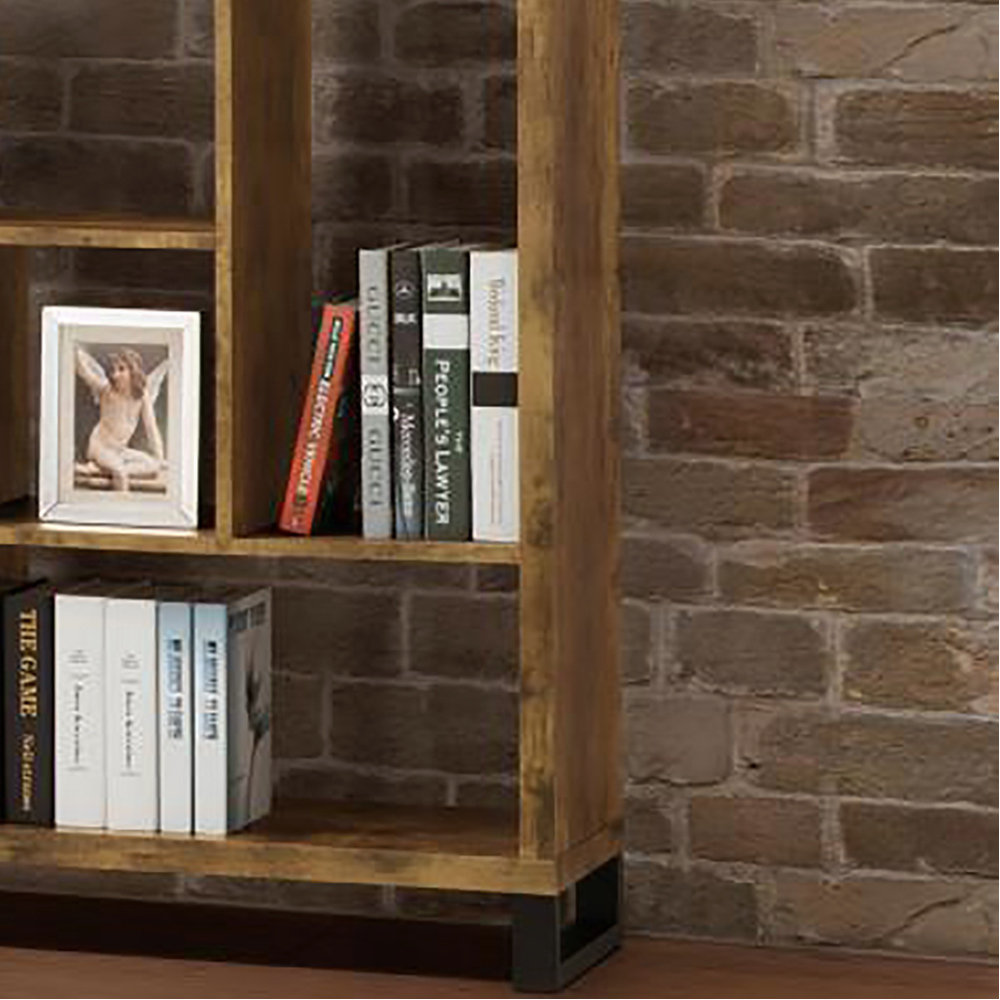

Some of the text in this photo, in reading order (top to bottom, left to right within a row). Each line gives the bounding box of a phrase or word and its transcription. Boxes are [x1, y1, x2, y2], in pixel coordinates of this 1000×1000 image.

[367, 286, 381, 363] GUCCI
[369, 428, 383, 507] GUCCI
[434, 359, 451, 525] PEOPLE'S LAWYER
[18, 608, 38, 717] THE GAME
